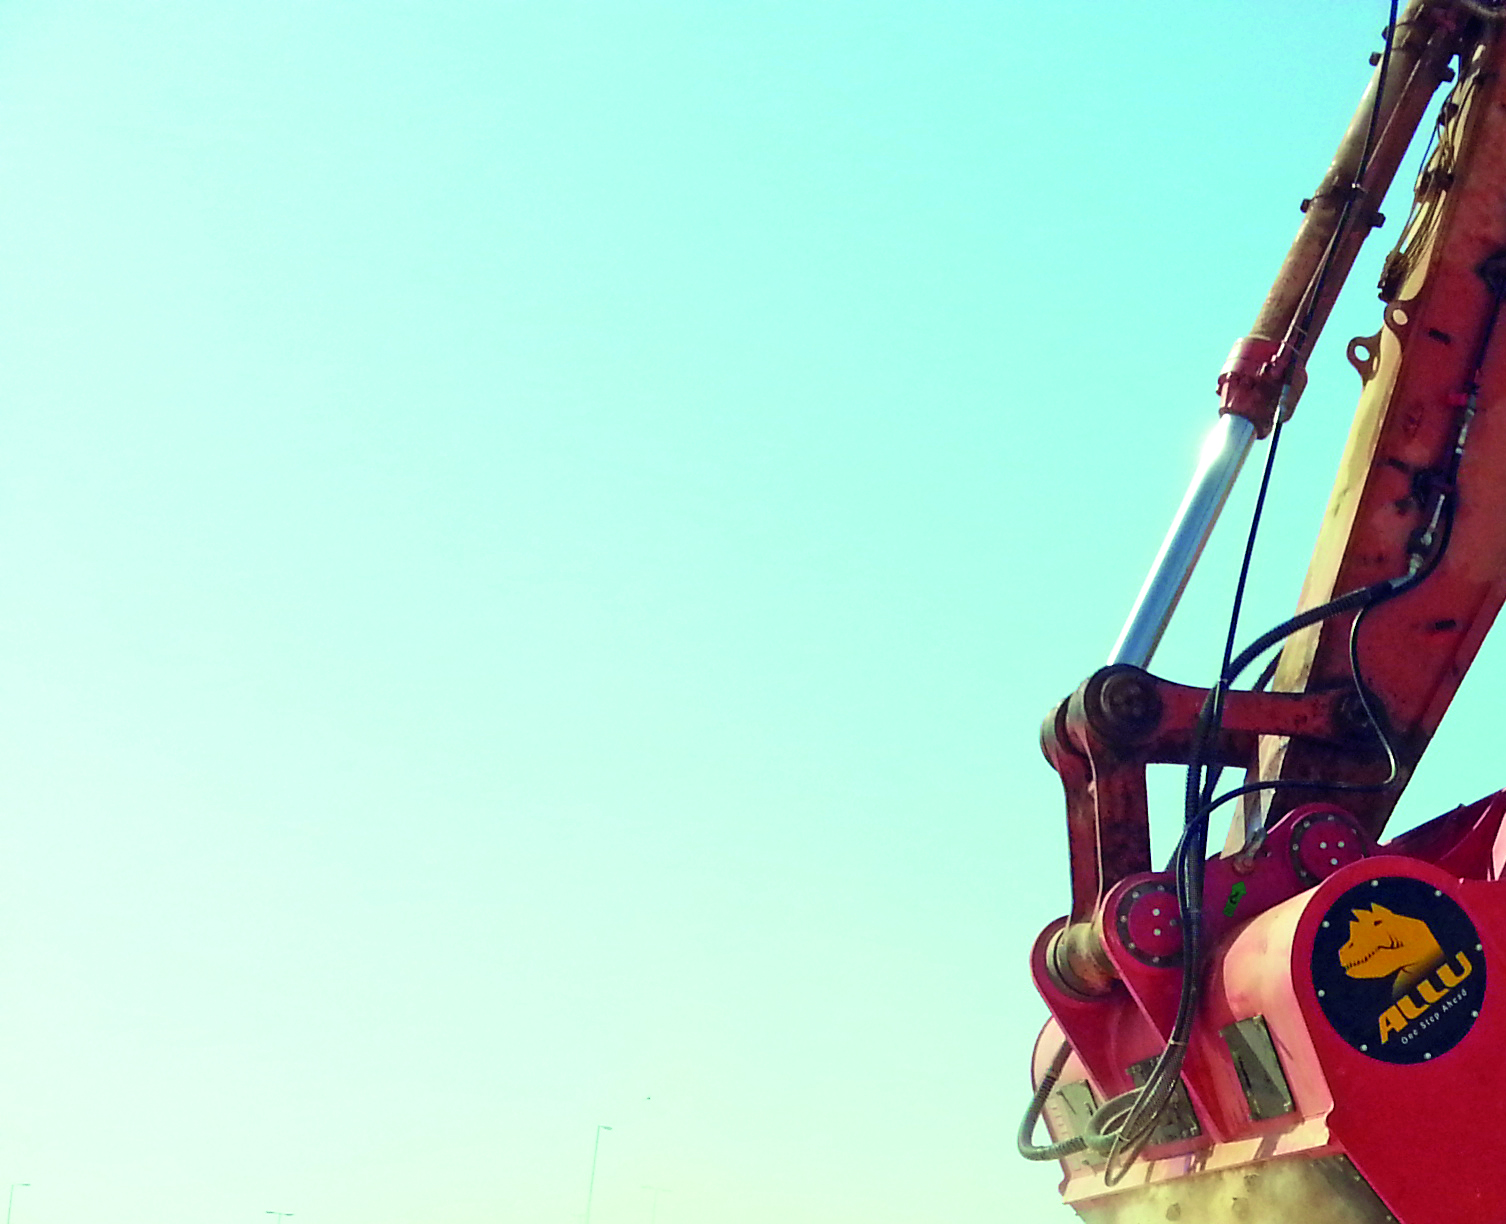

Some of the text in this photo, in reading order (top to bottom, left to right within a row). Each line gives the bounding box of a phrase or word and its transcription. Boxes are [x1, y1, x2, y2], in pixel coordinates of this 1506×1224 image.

[1379, 951, 1473, 1044] ALLU
[1401, 988, 1467, 1045] One Step Ahead
